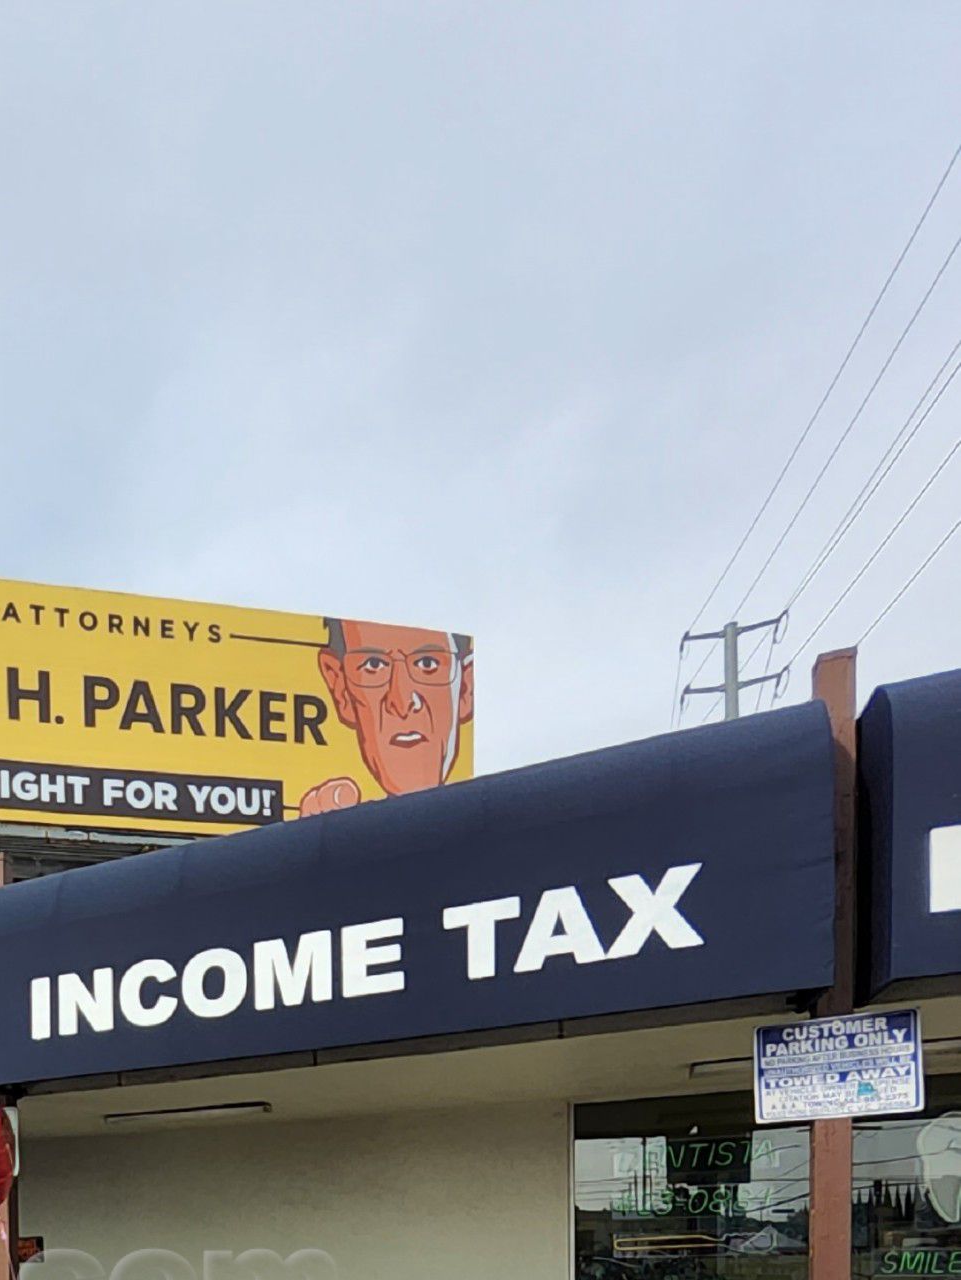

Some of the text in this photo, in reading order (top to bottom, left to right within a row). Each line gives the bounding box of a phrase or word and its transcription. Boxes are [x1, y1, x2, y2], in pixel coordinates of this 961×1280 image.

[2, 602, 222, 643] ATTORNEYS
[7, 667, 64, 724] H.
[83, 675, 329, 746] PARKER
[103, 779, 178, 811] FOR
[187, 785, 273, 816] YOU!
[30, 862, 705, 1041] INCOME TAX
[766, 1027, 908, 1057] PARKING ONLY
[782, 1016, 888, 1042] CUSTOMER
[766, 1066, 910, 1089] TOWED AWAY
